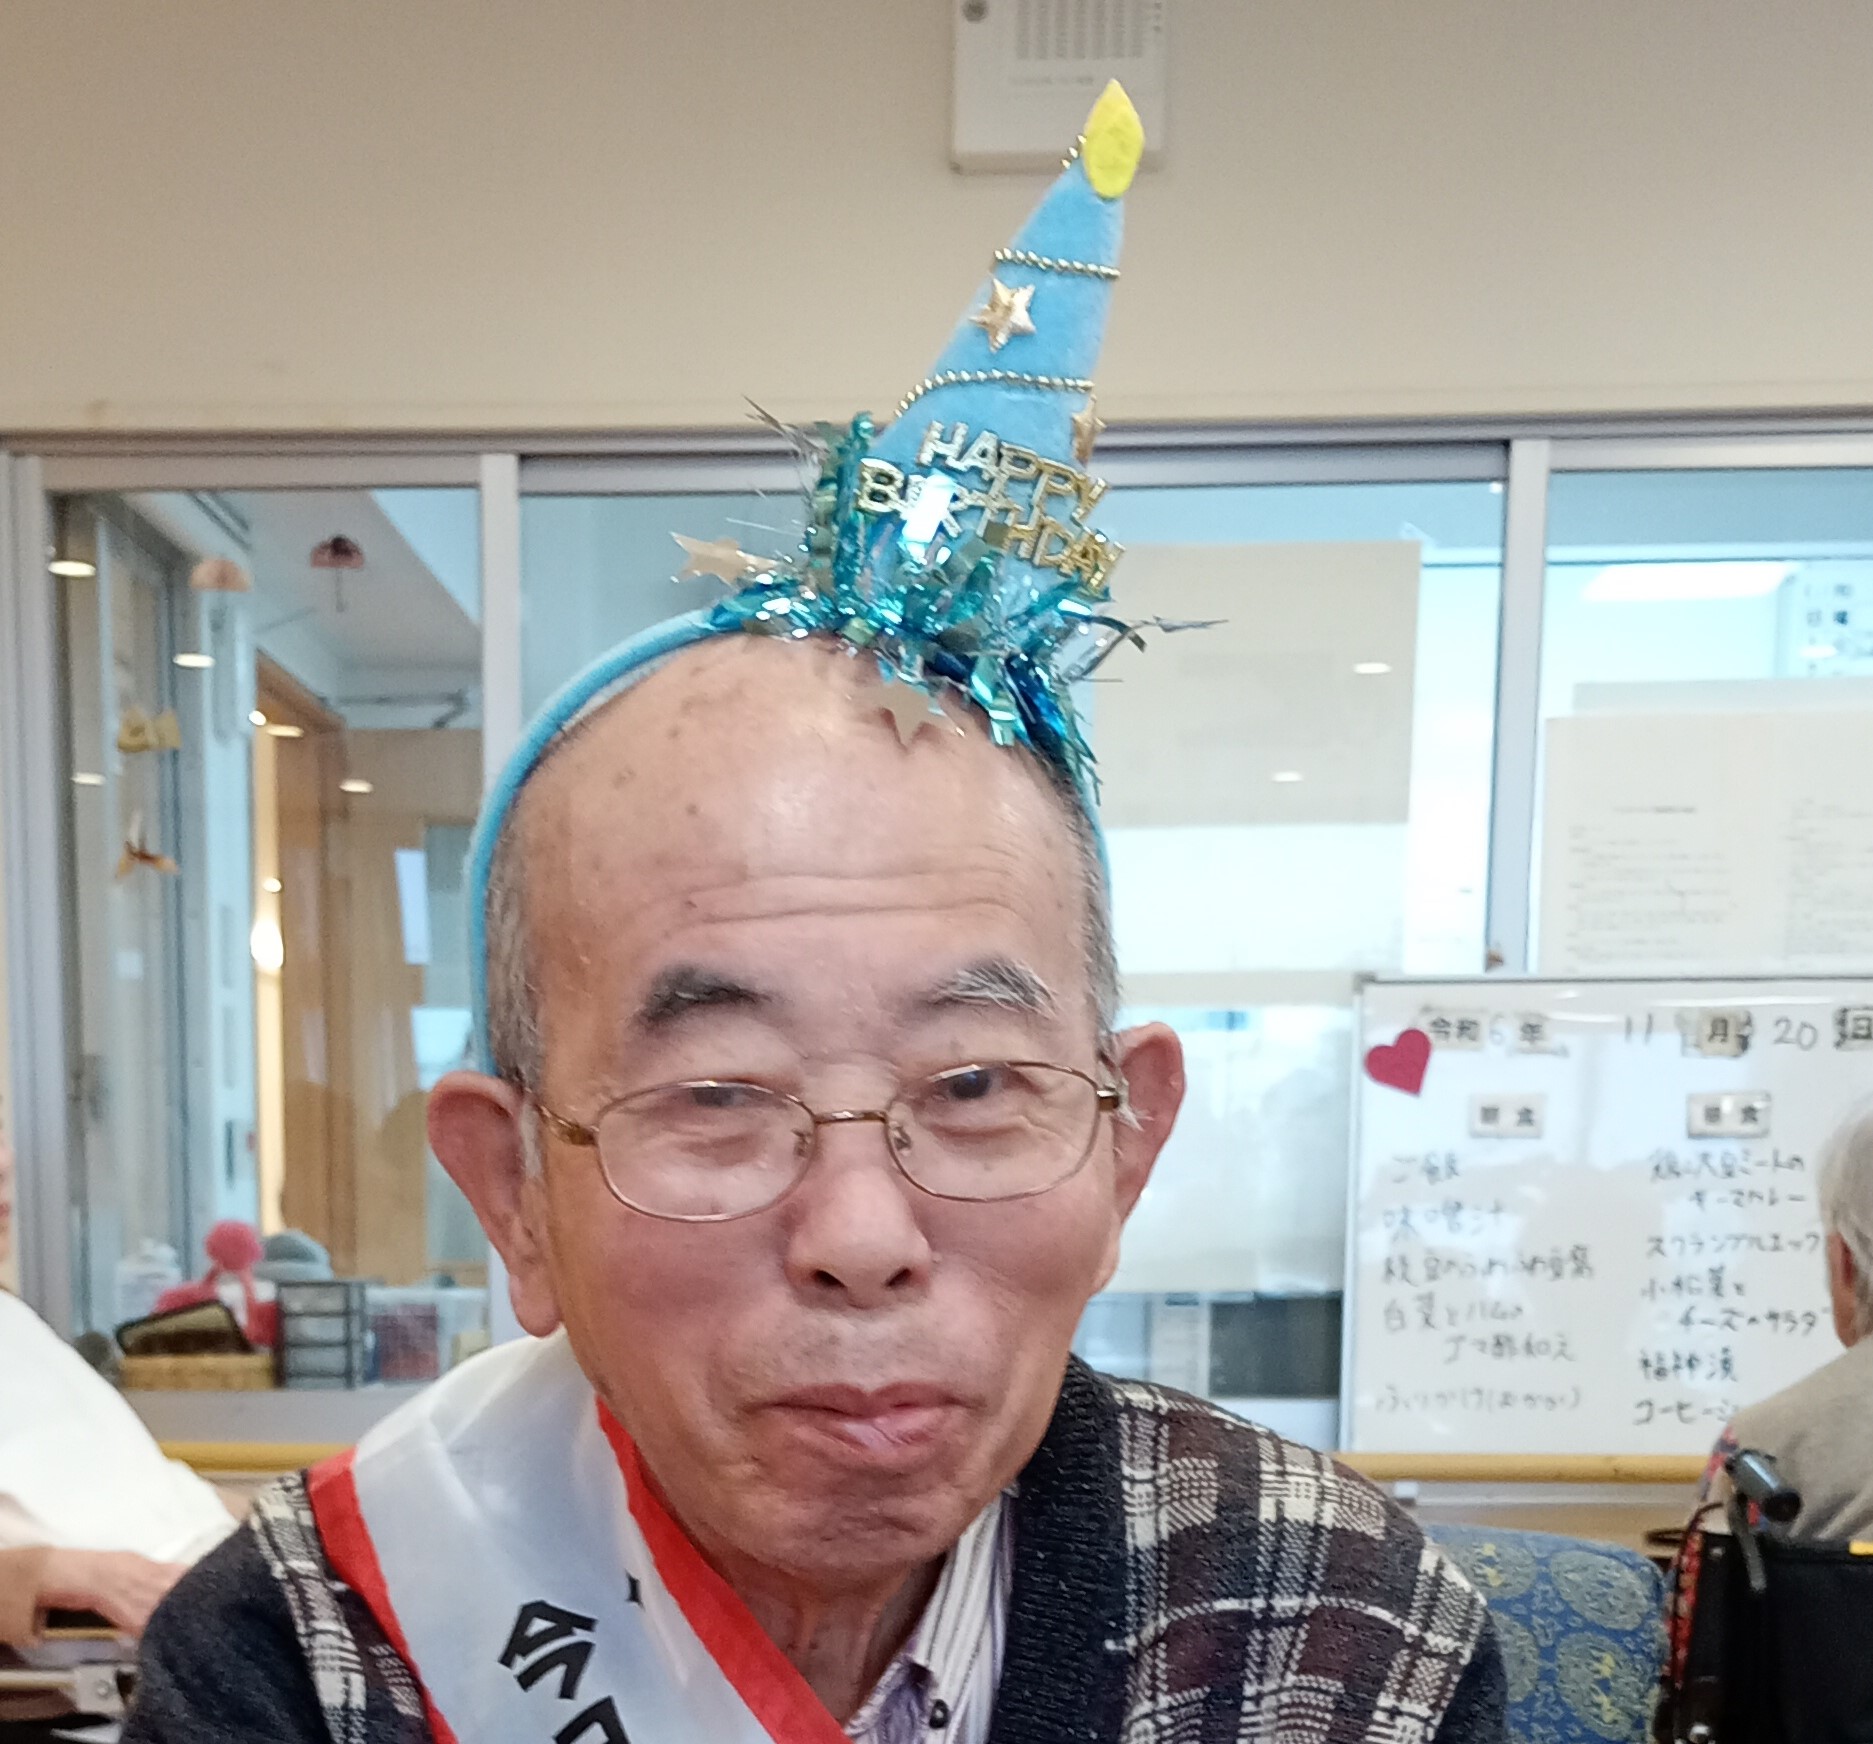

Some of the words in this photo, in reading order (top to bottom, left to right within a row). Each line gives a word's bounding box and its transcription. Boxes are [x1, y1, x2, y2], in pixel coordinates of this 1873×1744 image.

[916, 419, 1108, 520] HAPPY
[1707, 1016, 1729, 1043] 月
[1773, 1016, 1819, 1051] 20
